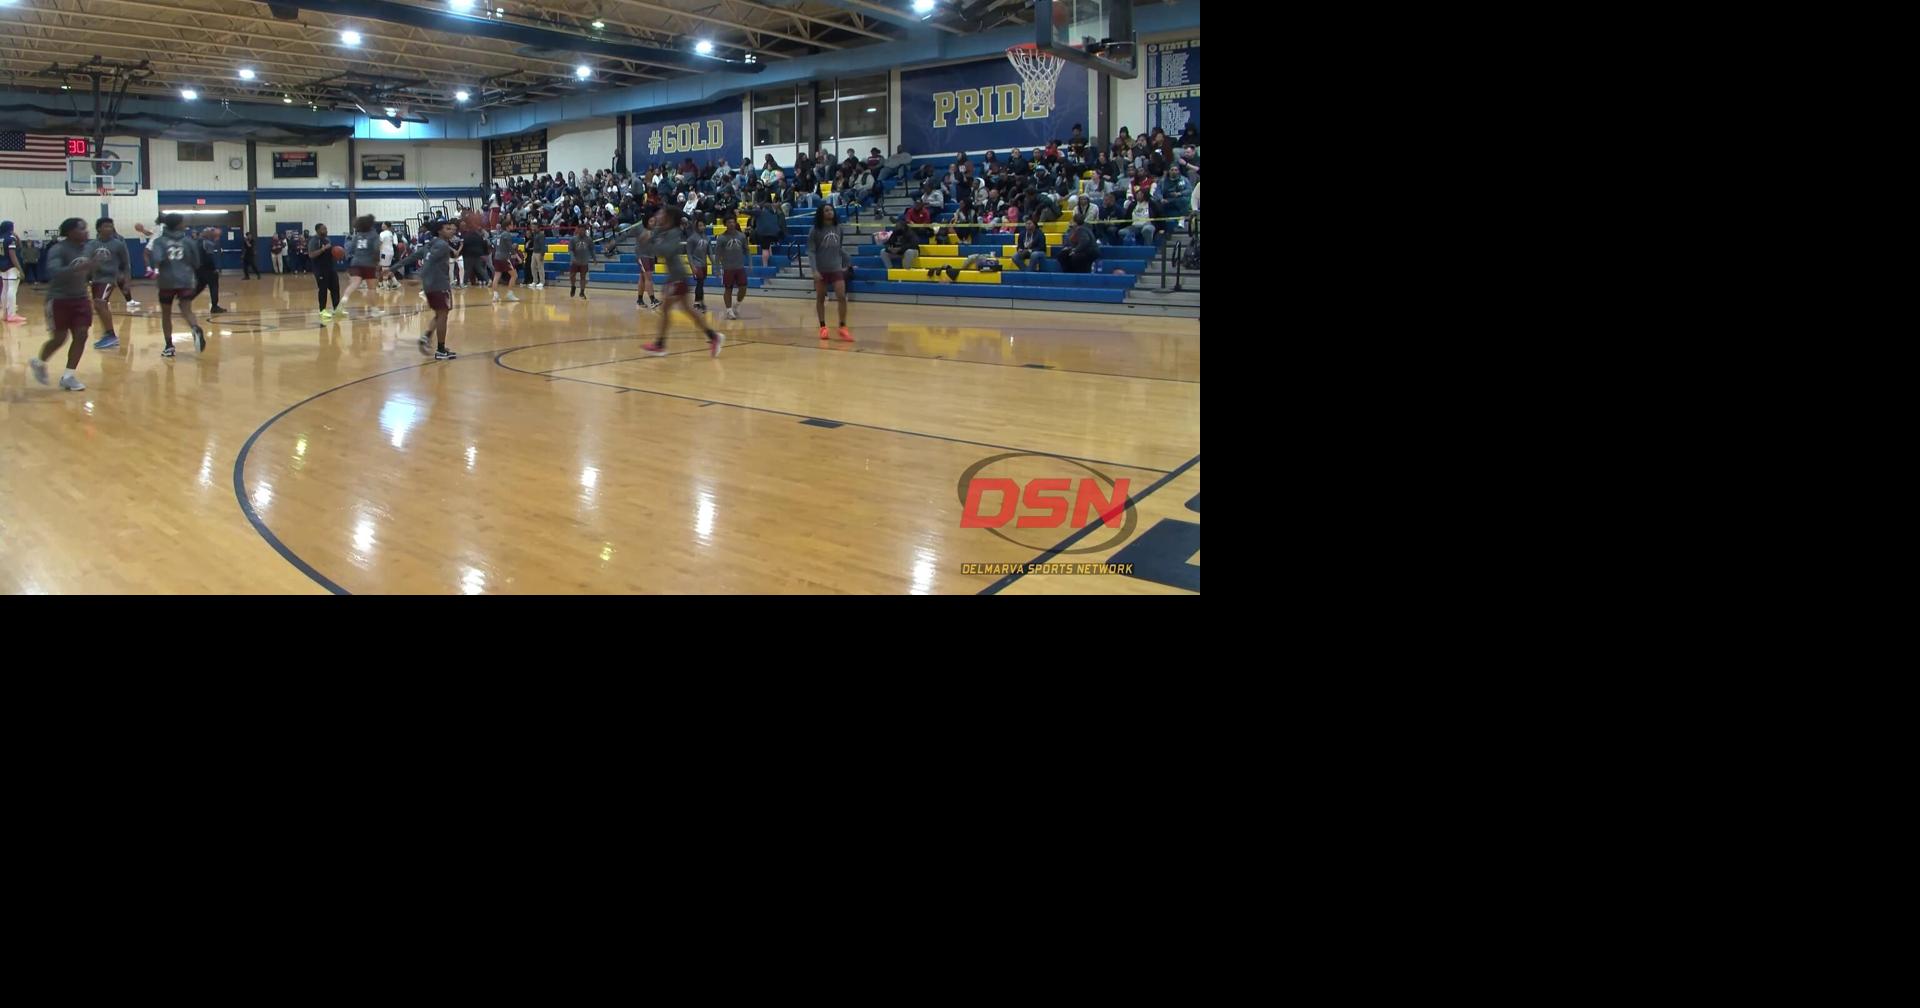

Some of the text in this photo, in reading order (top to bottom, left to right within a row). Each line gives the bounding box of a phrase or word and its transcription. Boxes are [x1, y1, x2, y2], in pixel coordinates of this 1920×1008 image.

[933, 83, 1049, 128] PRIDE
[69, 140, 85, 153] 30
[648, 119, 723, 155] #GOLD
